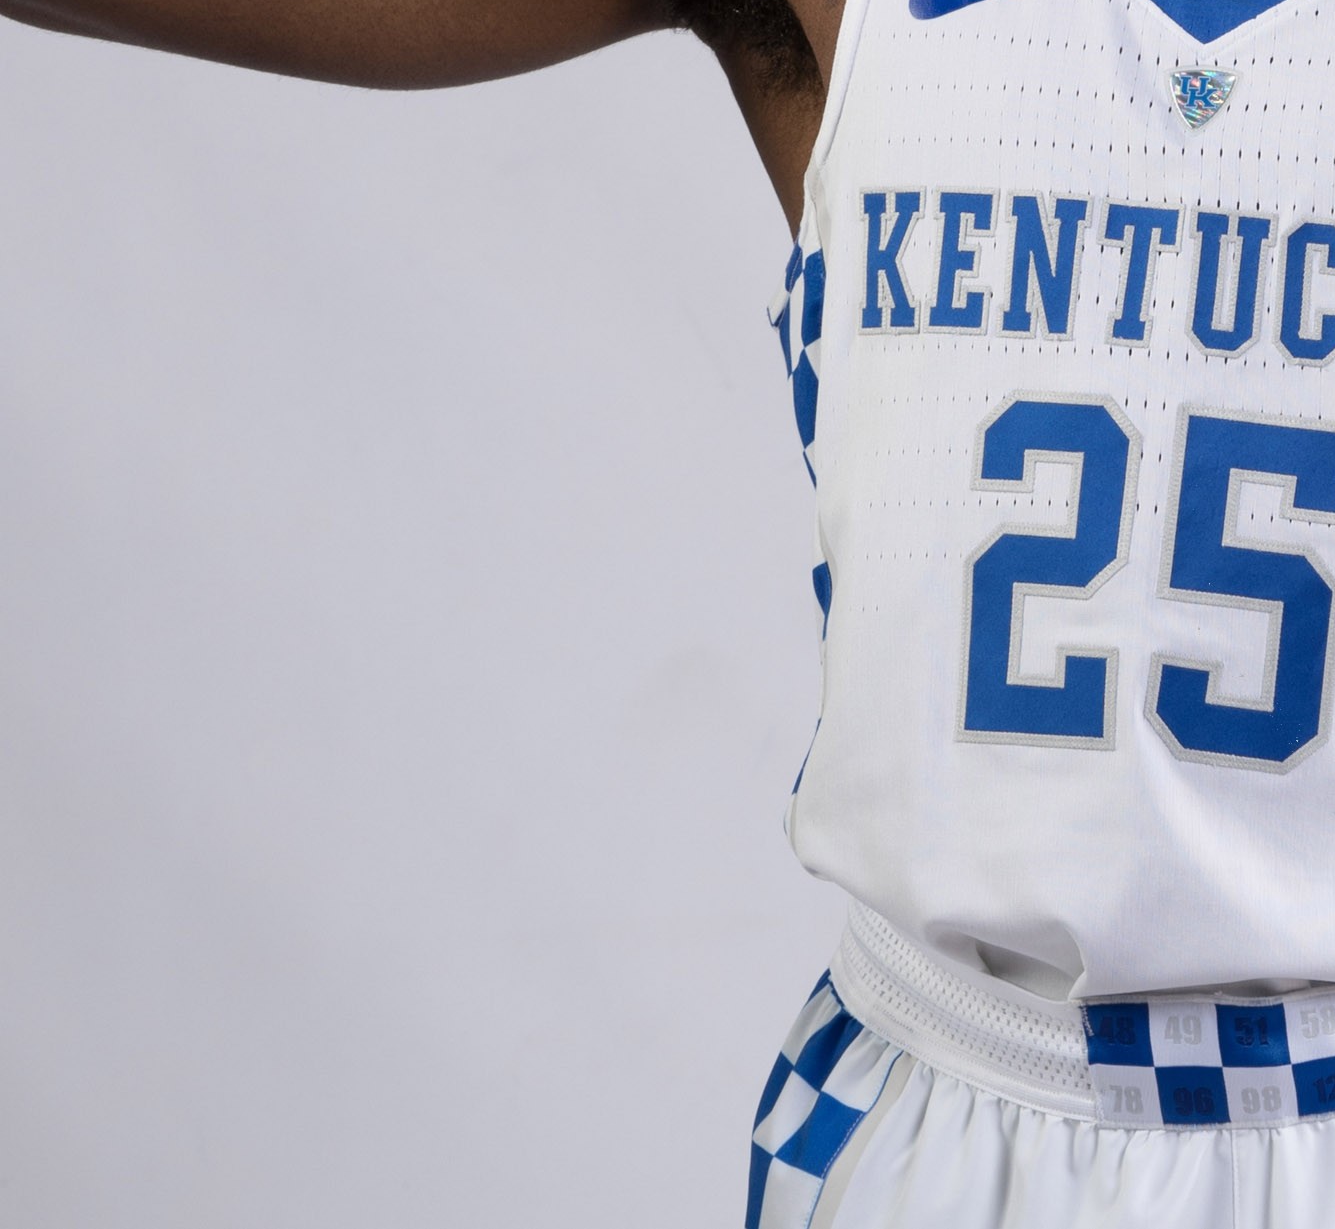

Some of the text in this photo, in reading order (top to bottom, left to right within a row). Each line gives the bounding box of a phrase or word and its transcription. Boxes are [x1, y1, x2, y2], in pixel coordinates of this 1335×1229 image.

[1179, 75, 1222, 109] UK
[1098, 1015, 1137, 1047] 48
[1163, 1014, 1203, 1046] 49
[1233, 1016, 1270, 1047] 51
[1109, 1084, 1144, 1115] 78
[1172, 1086, 1216, 1117] 96
[1240, 1085, 1283, 1115] 98
